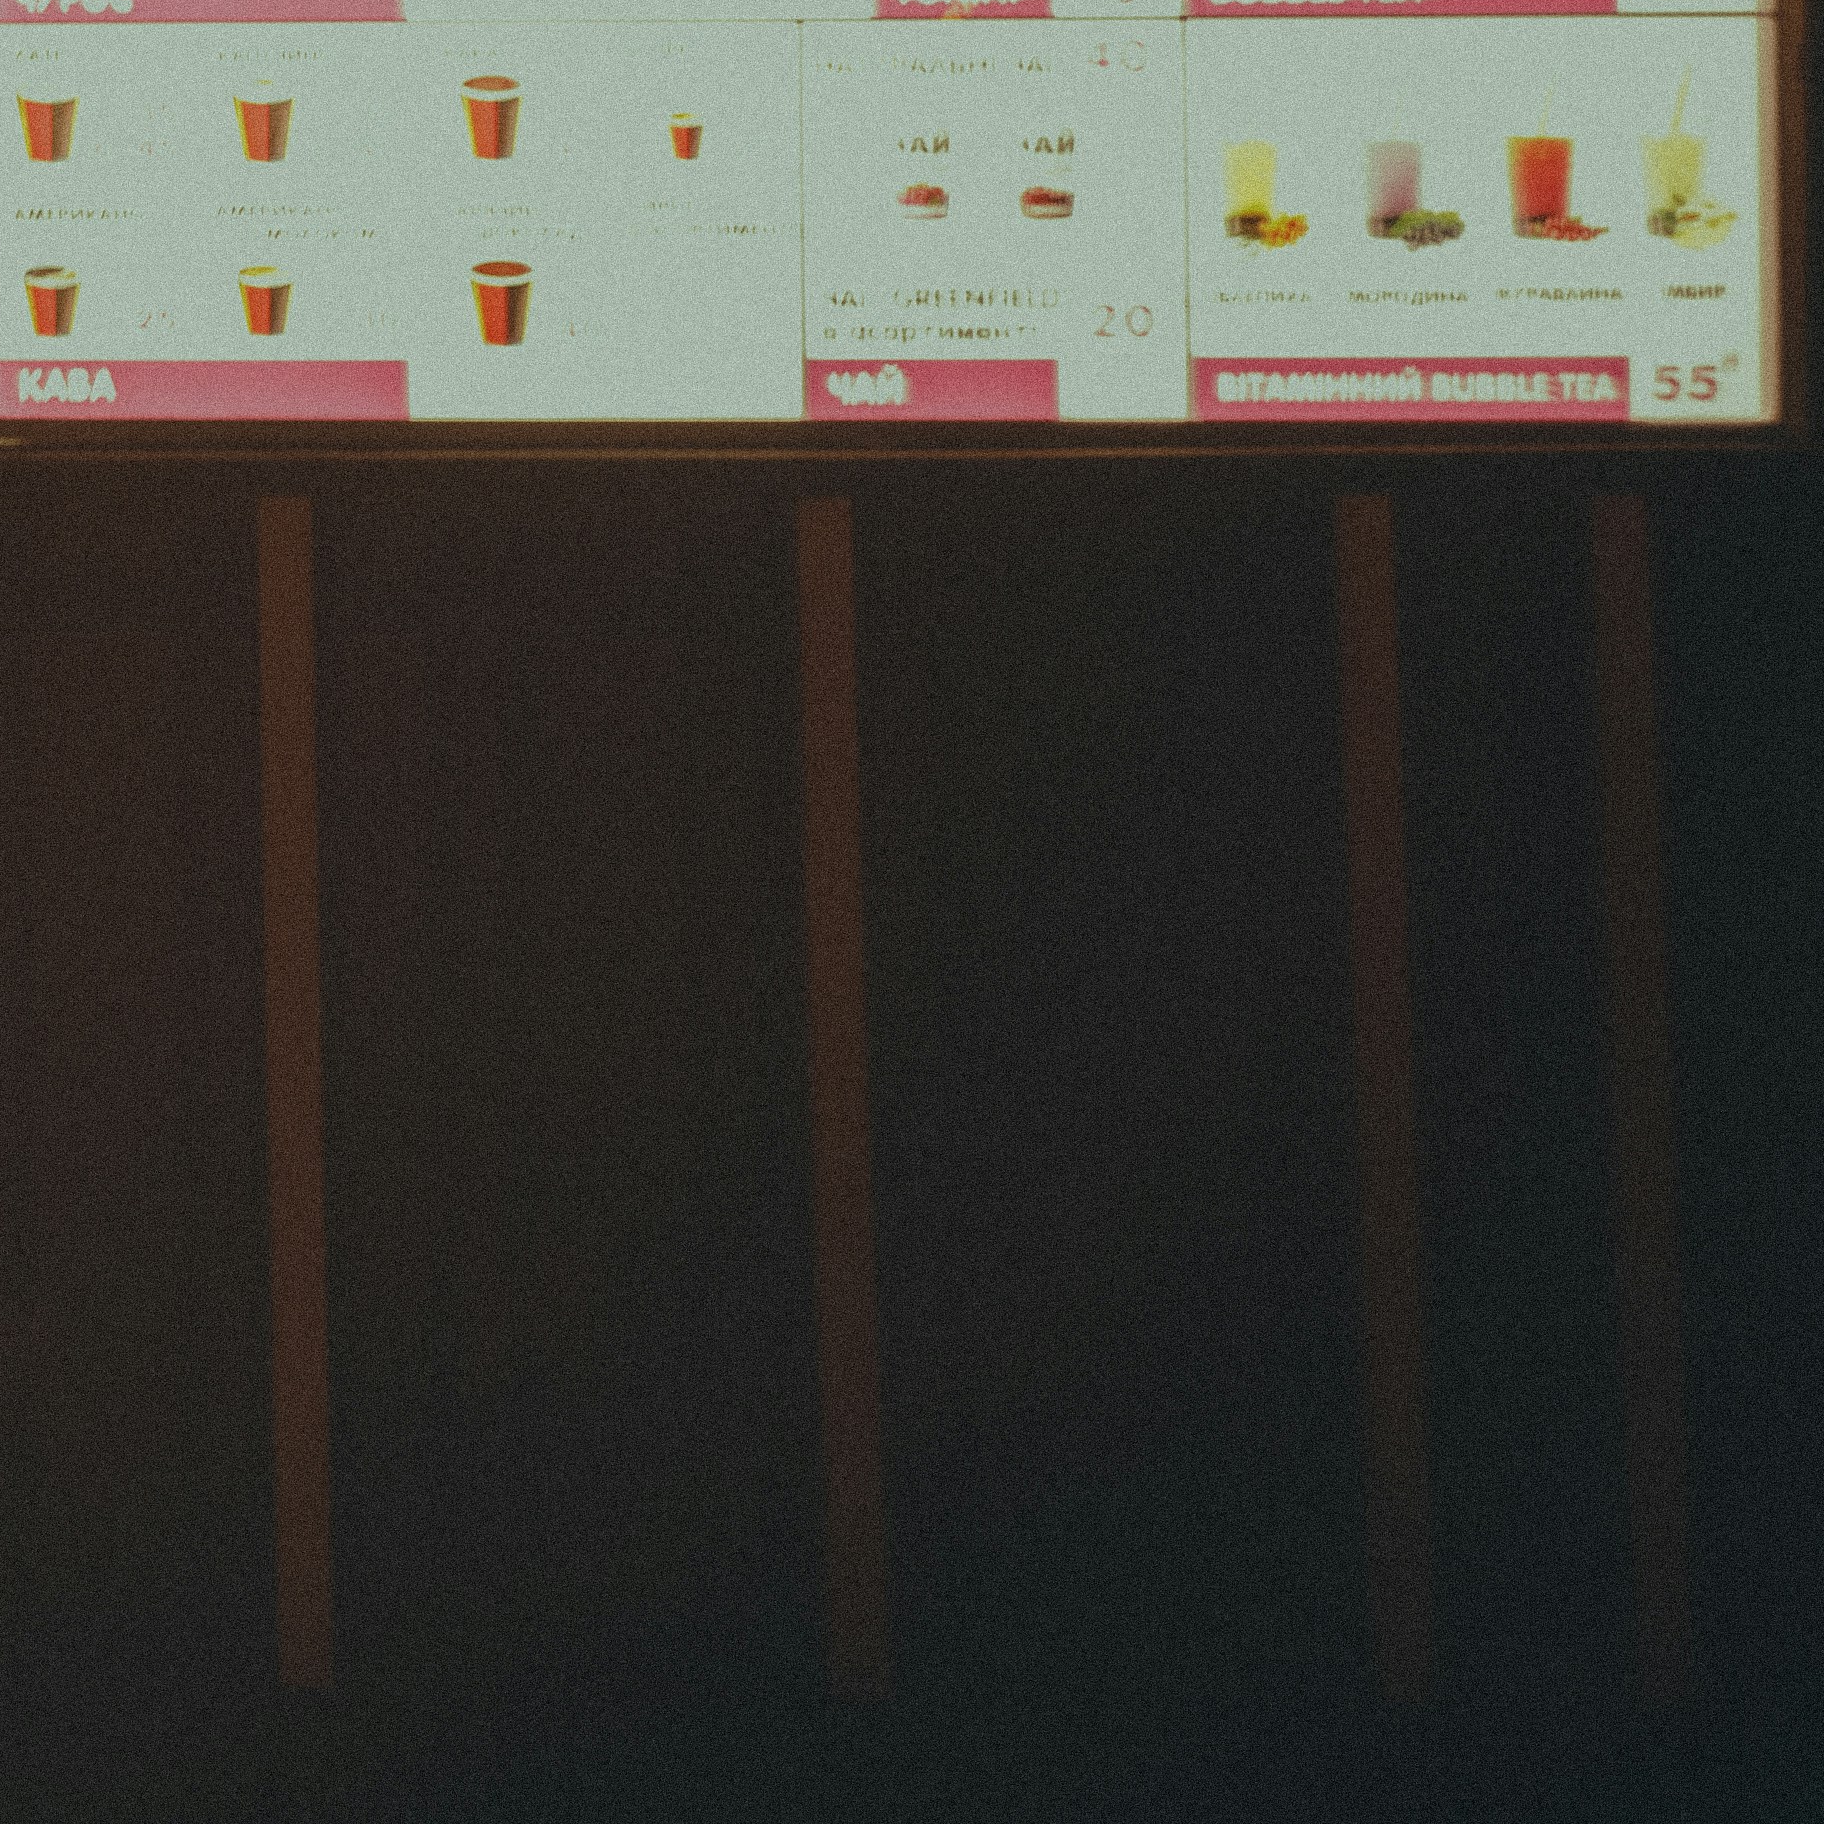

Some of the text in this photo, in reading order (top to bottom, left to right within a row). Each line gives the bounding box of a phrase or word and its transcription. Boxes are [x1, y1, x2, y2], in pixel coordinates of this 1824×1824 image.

[18, 367, 118, 404] КАВА
[1558, 373, 1618, 402] TEA
[1653, 364, 1719, 403] 55
